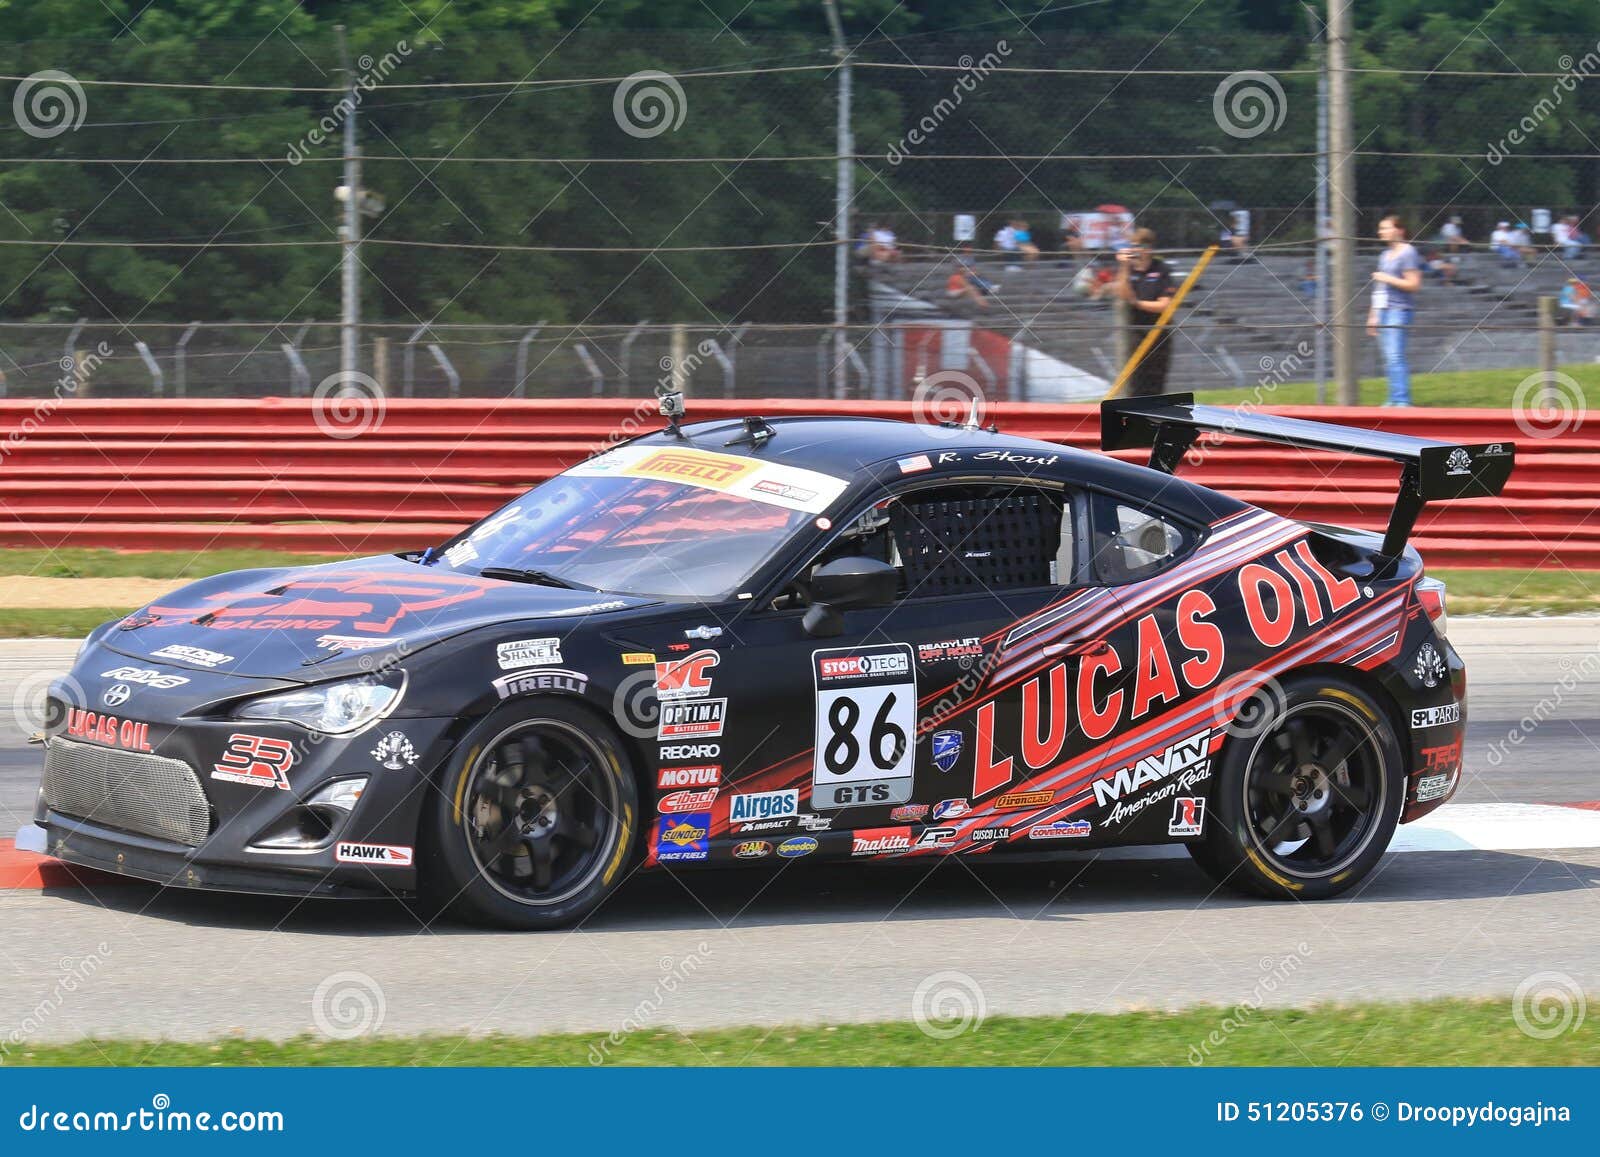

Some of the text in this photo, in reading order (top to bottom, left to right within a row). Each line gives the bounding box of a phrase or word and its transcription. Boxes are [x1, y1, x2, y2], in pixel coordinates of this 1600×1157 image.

[938, 451, 1058, 465] R. Stout
[638, 453, 745, 482] PIRELLI
[918, 637, 980, 650] READYLIFT
[972, 539, 1361, 799] LUCAS OIL
[492, 668, 588, 700] PIRELLI
[665, 705, 720, 723] OPTIMA
[1413, 710, 1433, 727] SPL
[68, 708, 151, 752] LUCAS OIL
[824, 692, 907, 775] 86
[660, 744, 720, 760] RECARO
[660, 768, 719, 786] MOTUL
[833, 784, 889, 804] GTS
[732, 794, 794, 818] Airgas
[1099, 784, 1175, 828] American
[663, 829, 704, 840] SUNOCO
[972, 829, 992, 840] CUSCO
[1032, 827, 1091, 838] COVERCRAFT
[341, 845, 386, 859] HAWK
[658, 851, 708, 860] RACE FUELS
[779, 842, 815, 853] speedco
